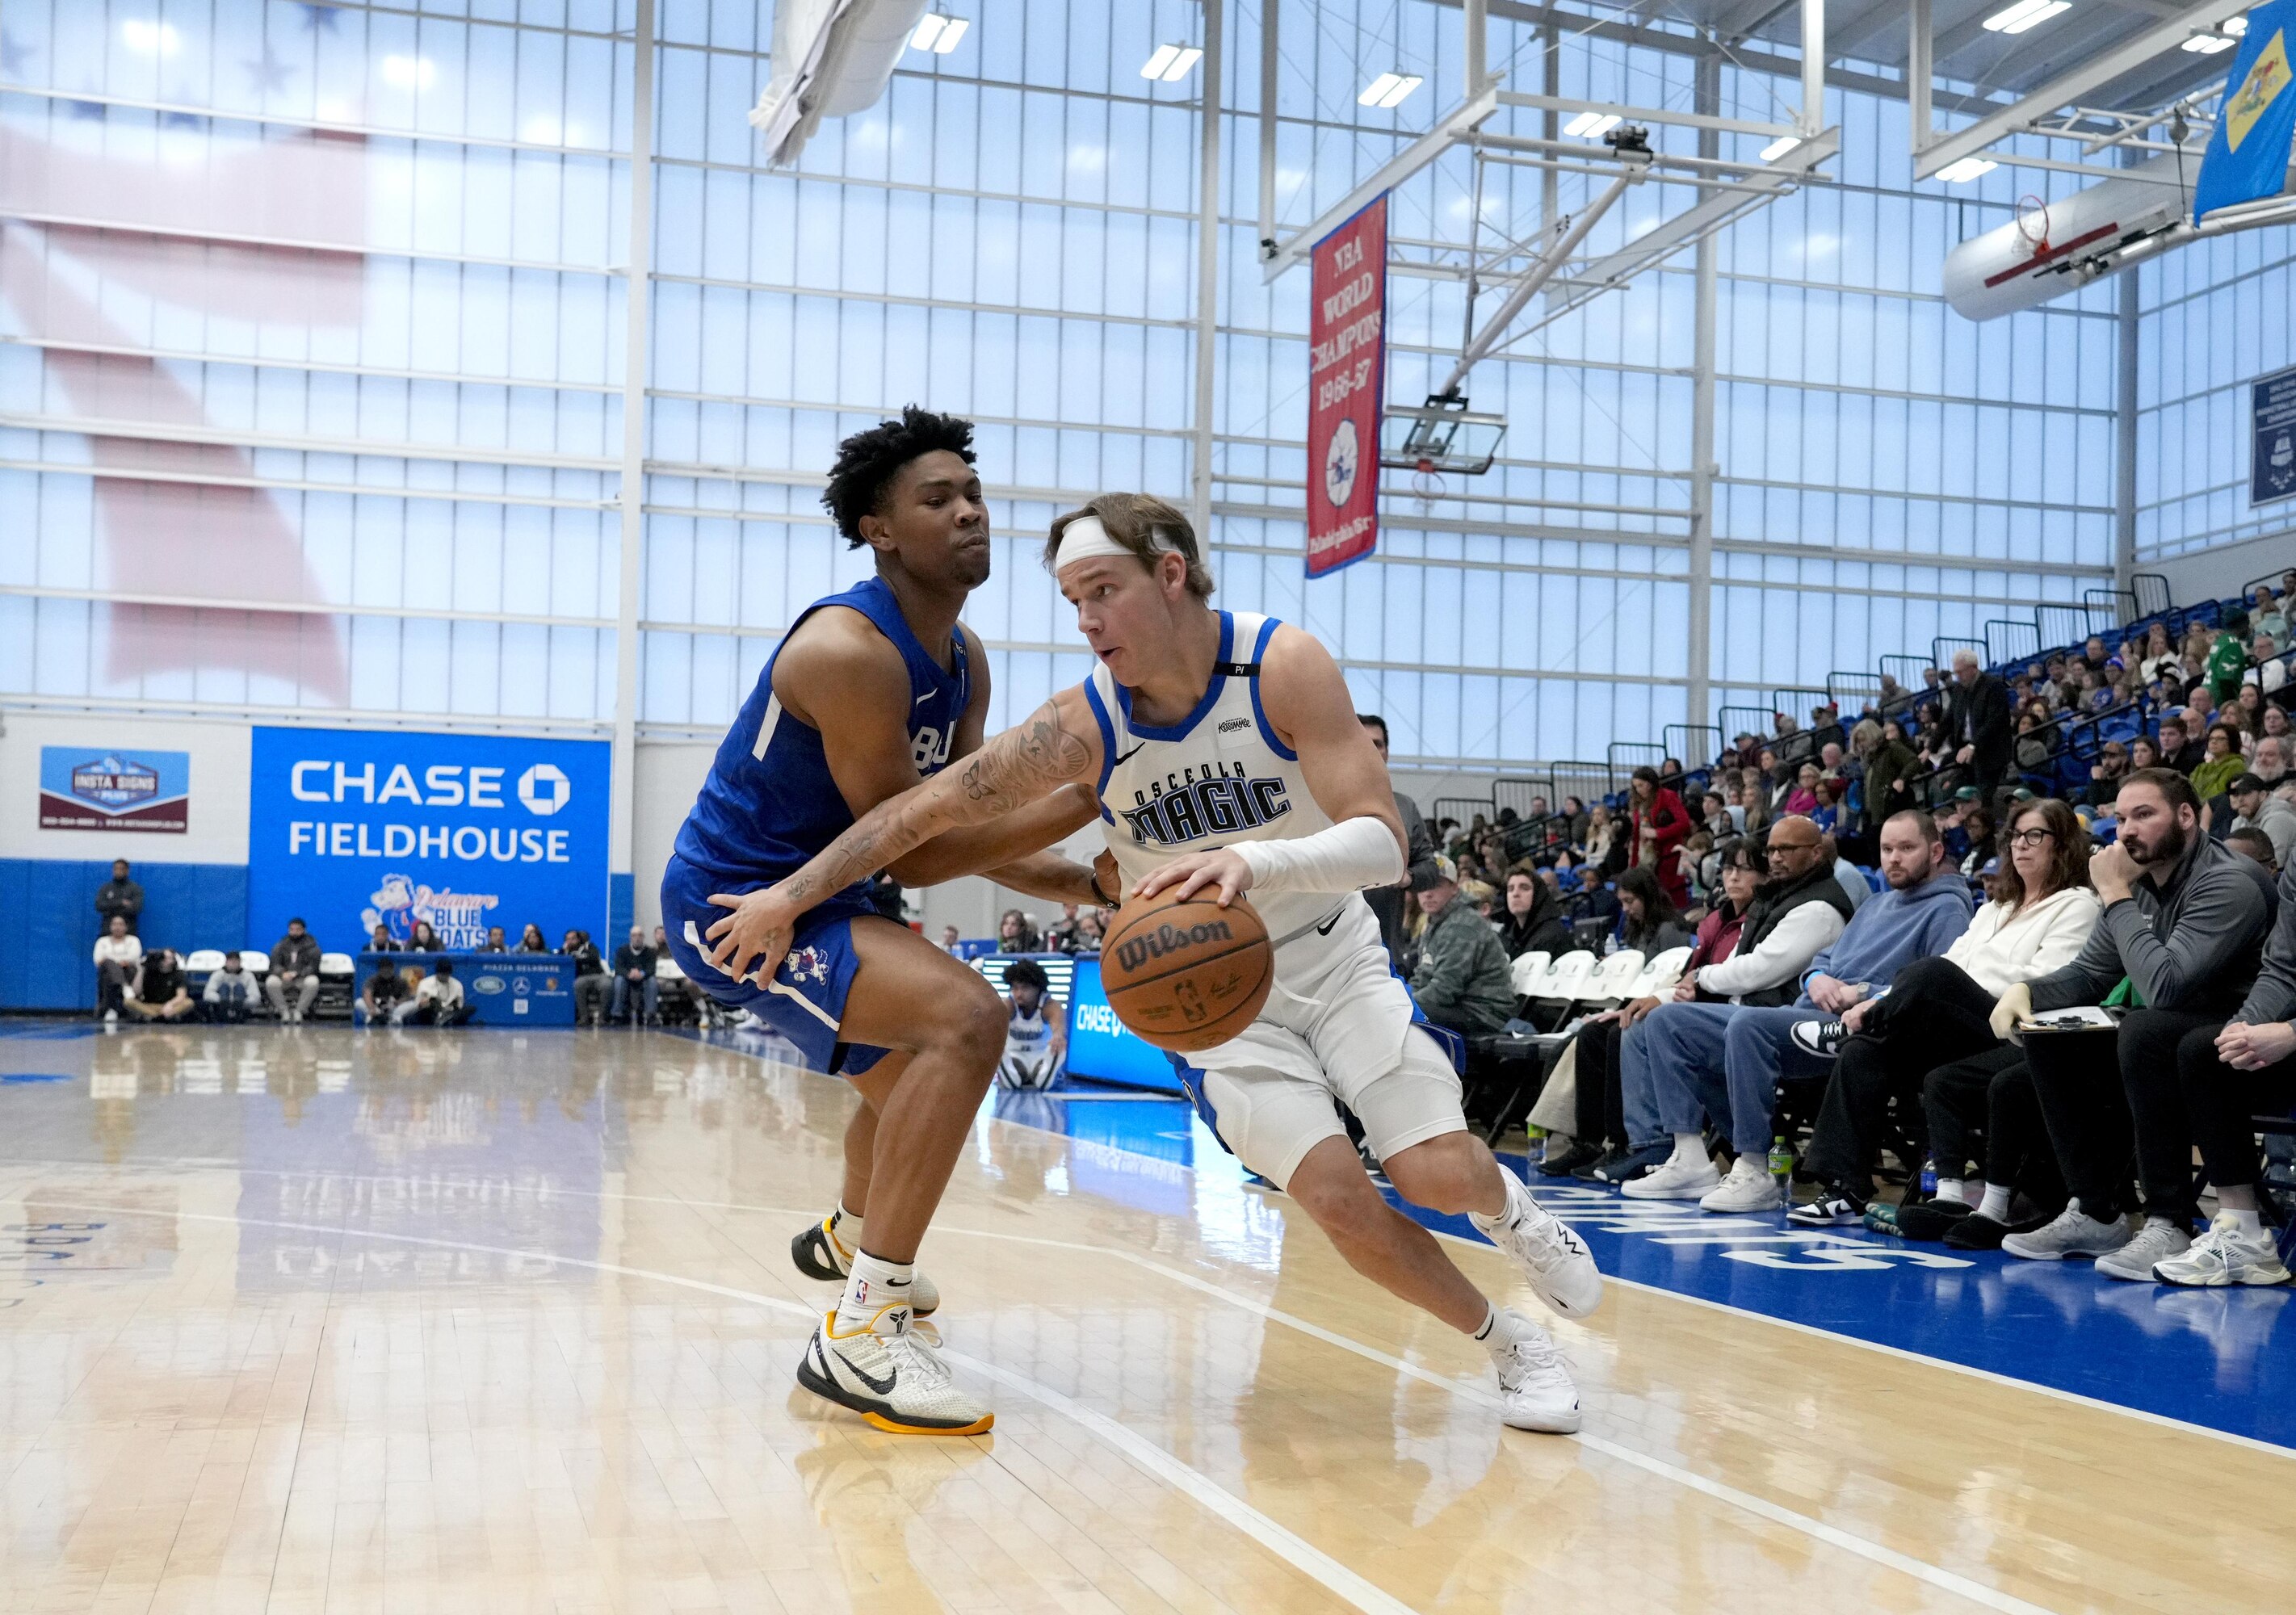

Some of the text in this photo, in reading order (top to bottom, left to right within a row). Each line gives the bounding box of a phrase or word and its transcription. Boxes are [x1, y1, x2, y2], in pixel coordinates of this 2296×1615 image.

[1323, 272, 1374, 325] WORLD
[1320, 358, 1371, 411] 1966-67
[74, 774, 155, 791] INSTA SIGNS
[291, 760, 506, 808] CHASE
[1135, 761, 1246, 806] OSCEOLA
[1118, 778, 1292, 845] MAGIC
[290, 821, 570, 862] FIELDHOUSE
[415, 886, 499, 911] Delaware
[435, 908, 481, 927] BLUE
[1116, 919, 1233, 973] Wilson
[1077, 1004, 1112, 1034] CHASE
